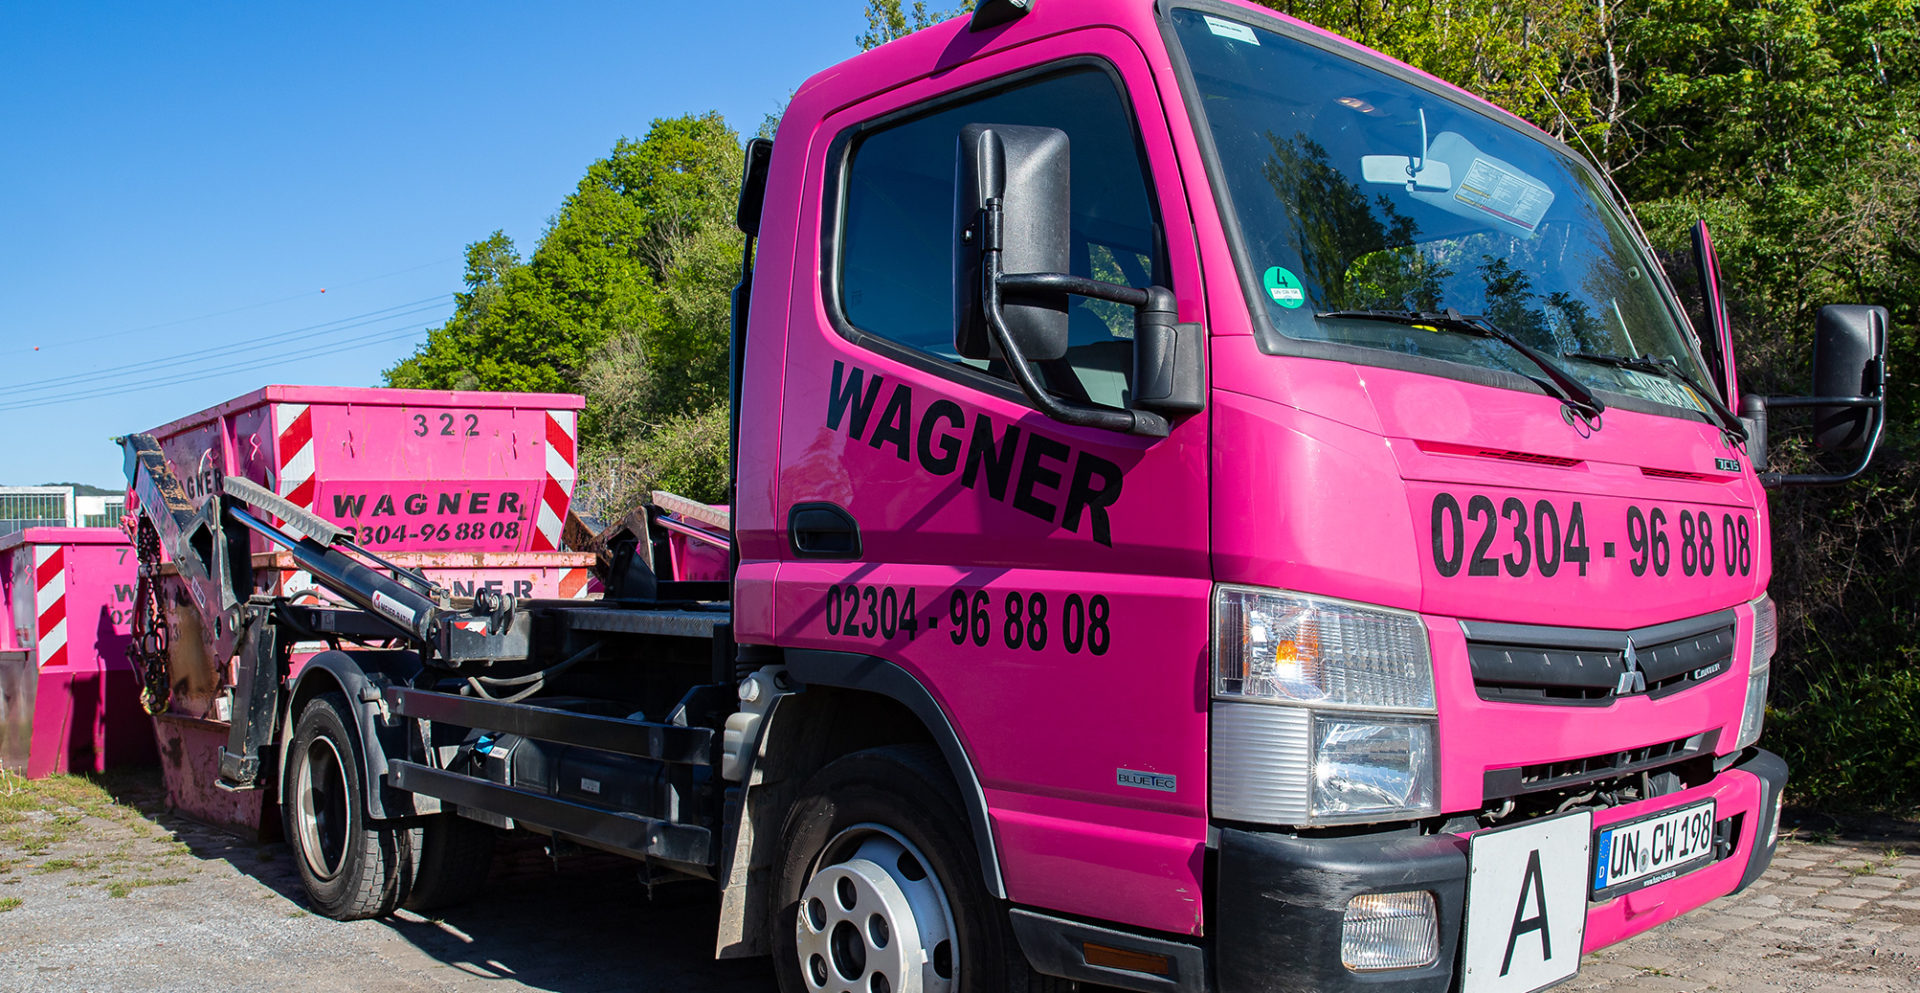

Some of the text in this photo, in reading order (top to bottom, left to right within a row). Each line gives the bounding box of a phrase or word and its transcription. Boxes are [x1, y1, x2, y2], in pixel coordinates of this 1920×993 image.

[1277, 268, 1288, 288] 4
[826, 360, 1123, 548] WAGNER
[179, 468, 224, 500] GNER
[333, 492, 519, 518] WAGNER
[1431, 492, 1751, 577] 02304 - 96 88 08
[826, 585, 1110, 656] 02304 - 96 88 08
[1118, 774, 1175, 788] BLUETEC
[1611, 809, 1711, 879] UN CW 198
[1599, 866, 1605, 879] D
[1499, 849, 1552, 977] A
